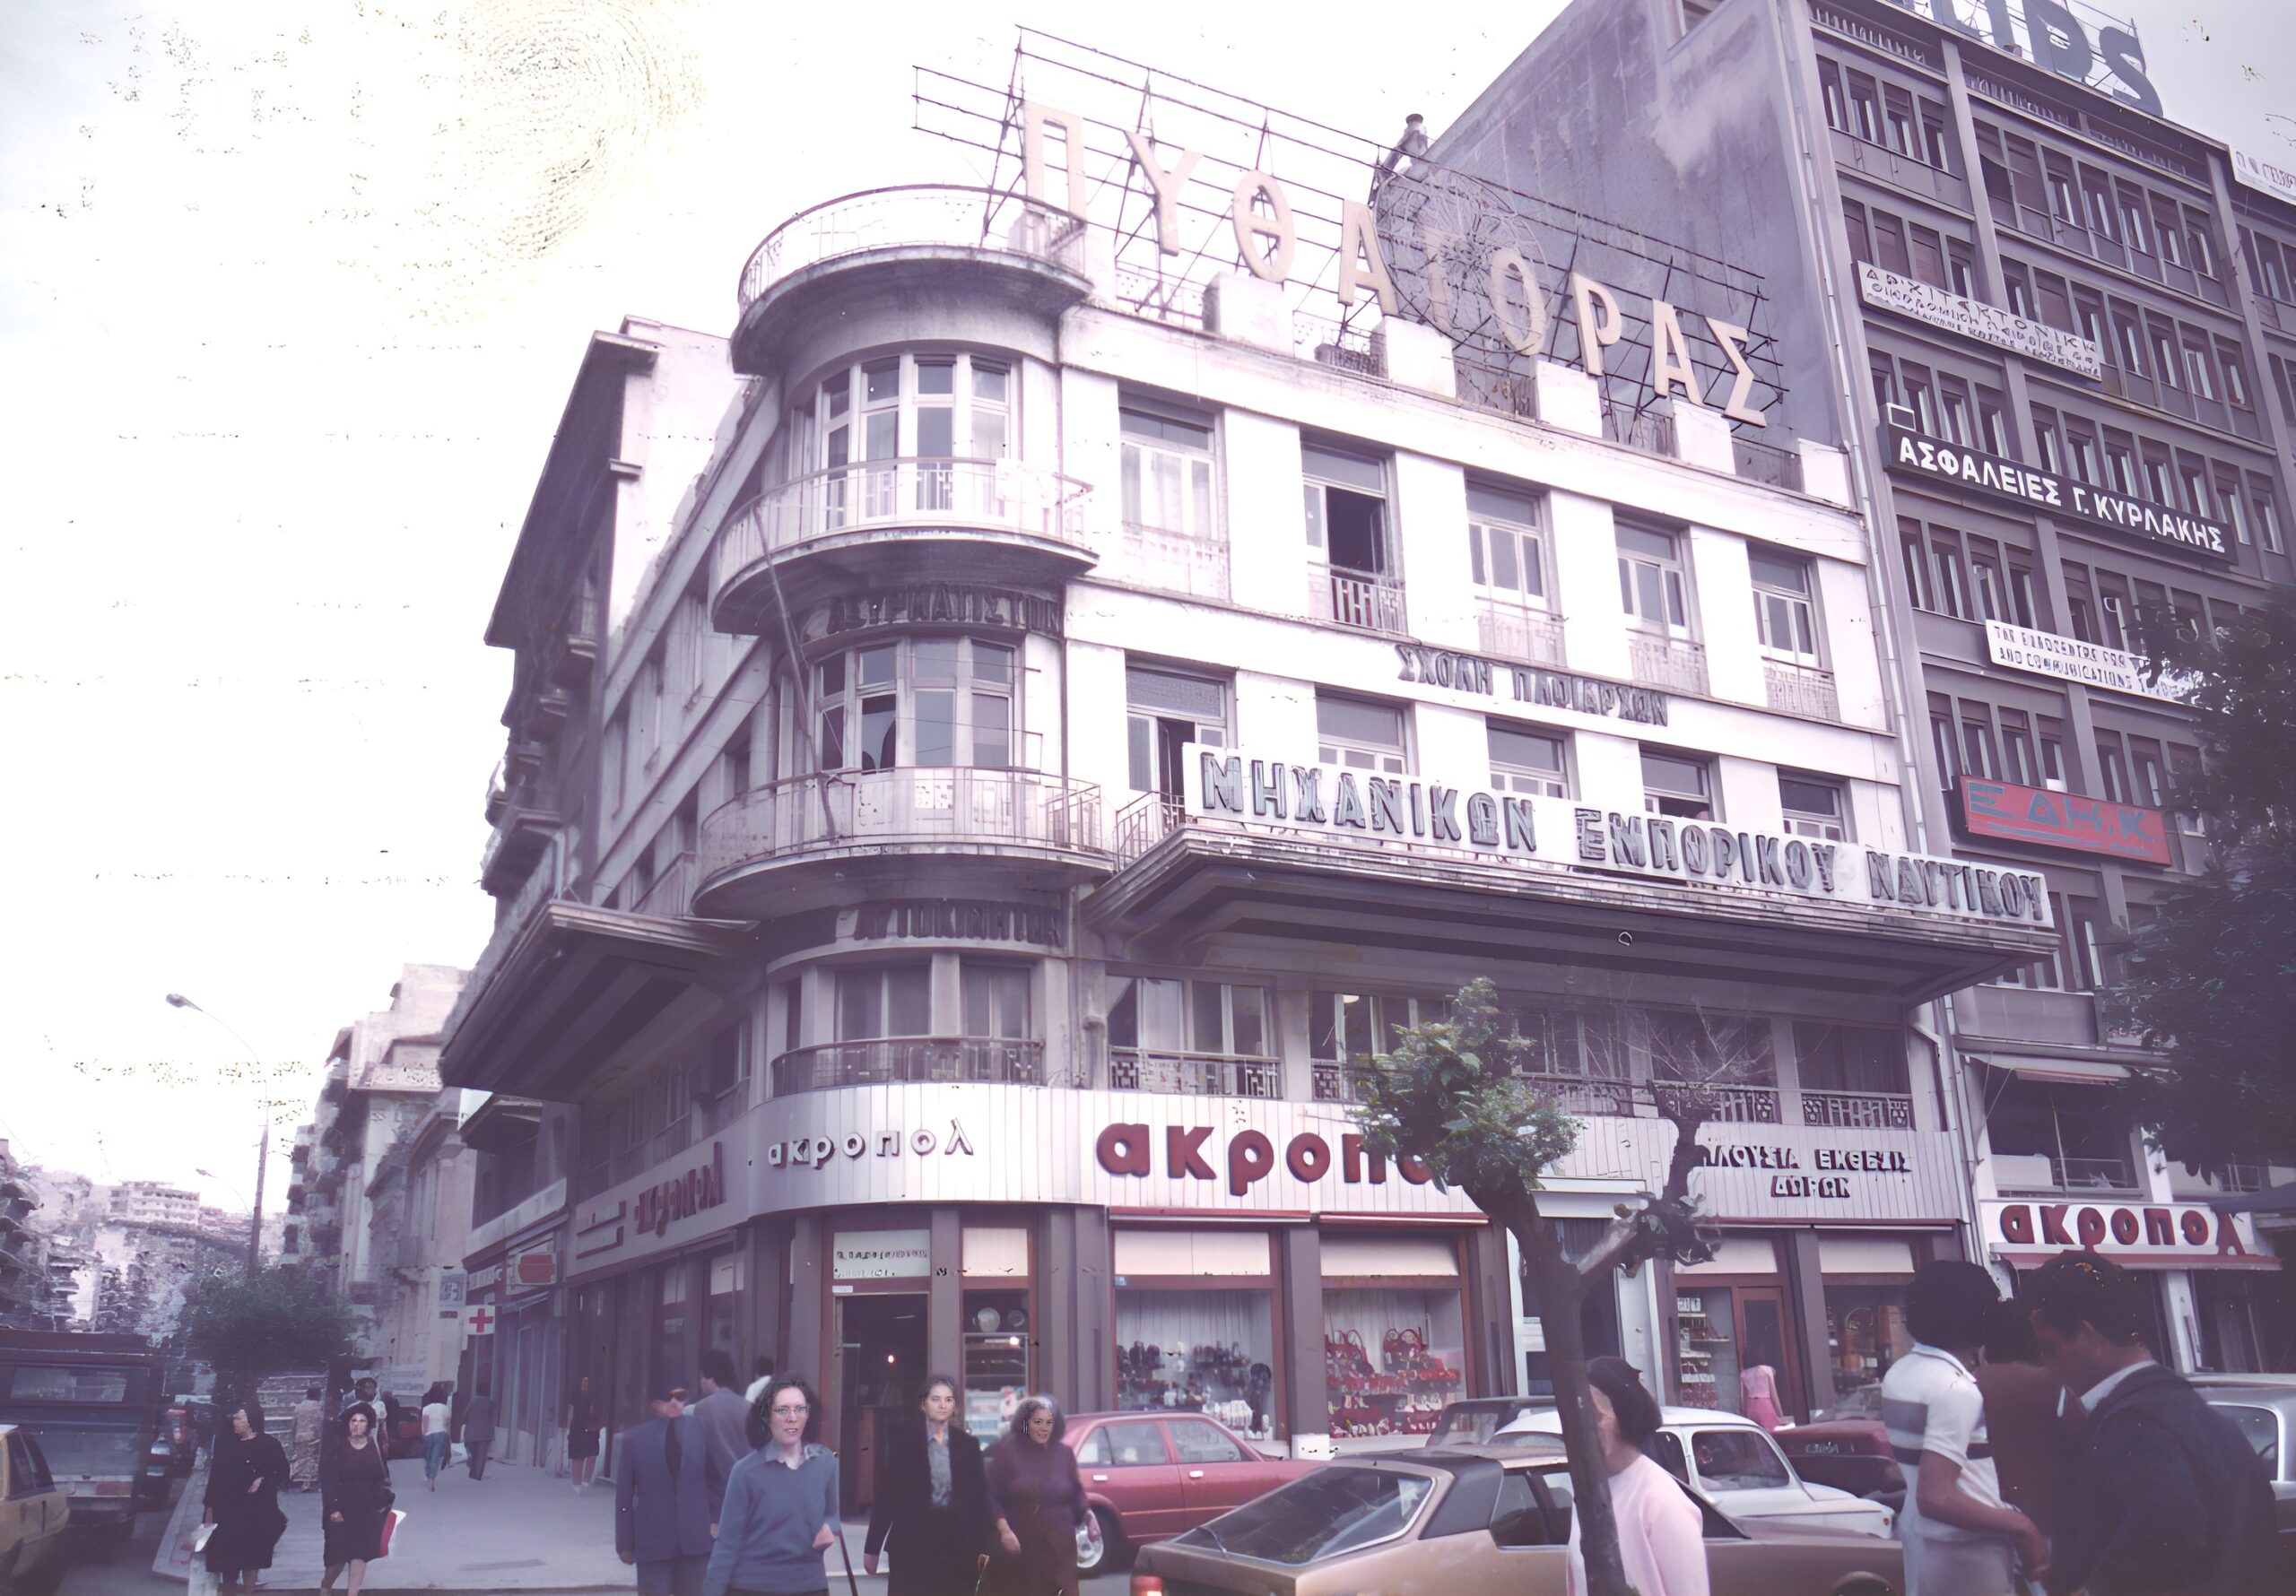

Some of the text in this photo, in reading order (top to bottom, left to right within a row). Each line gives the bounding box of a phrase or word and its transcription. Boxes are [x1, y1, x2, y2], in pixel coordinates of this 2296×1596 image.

[1022, 100, 1769, 428] ΠΥΘΑΓΟΡΑΣ
[1899, 436, 2063, 507] ΑΣΦΑΛΕΙΕΣ
[1395, 643, 1493, 696] ΣΧΟΛΗ
[1200, 750, 1537, 853] ΜΗΧΑΝΙΚΩΝ
[1866, 849, 2044, 922] ΝΑΥΤΙΚΟΥ
